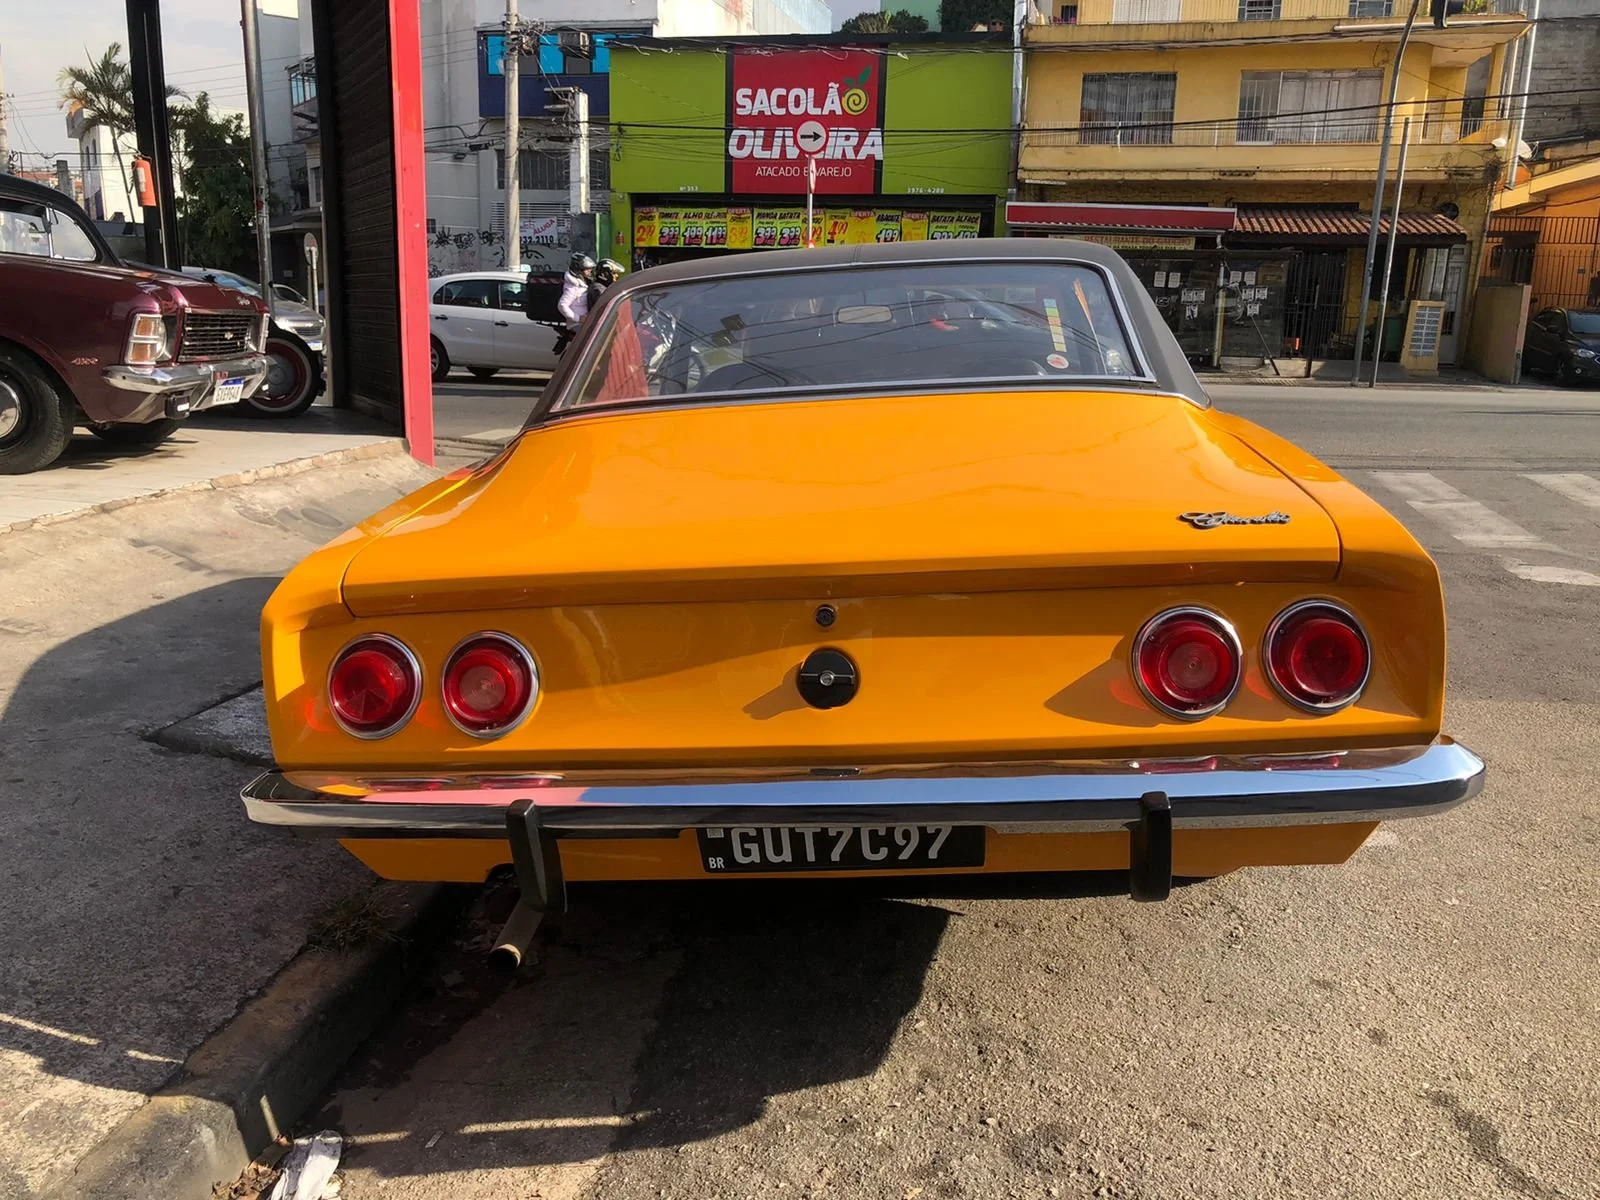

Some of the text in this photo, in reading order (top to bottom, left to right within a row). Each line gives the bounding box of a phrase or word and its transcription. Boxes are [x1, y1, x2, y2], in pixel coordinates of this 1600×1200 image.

[728, 127, 884, 160] OLIVIRA
[755, 166, 799, 177] ATACADO
[815, 166, 852, 177] VAREJO
[533, 219, 556, 235] ALUGA
[520, 235, 554, 245] 32.2110
[731, 825, 953, 863] GUT7C97
[708, 857, 725, 869] BR
